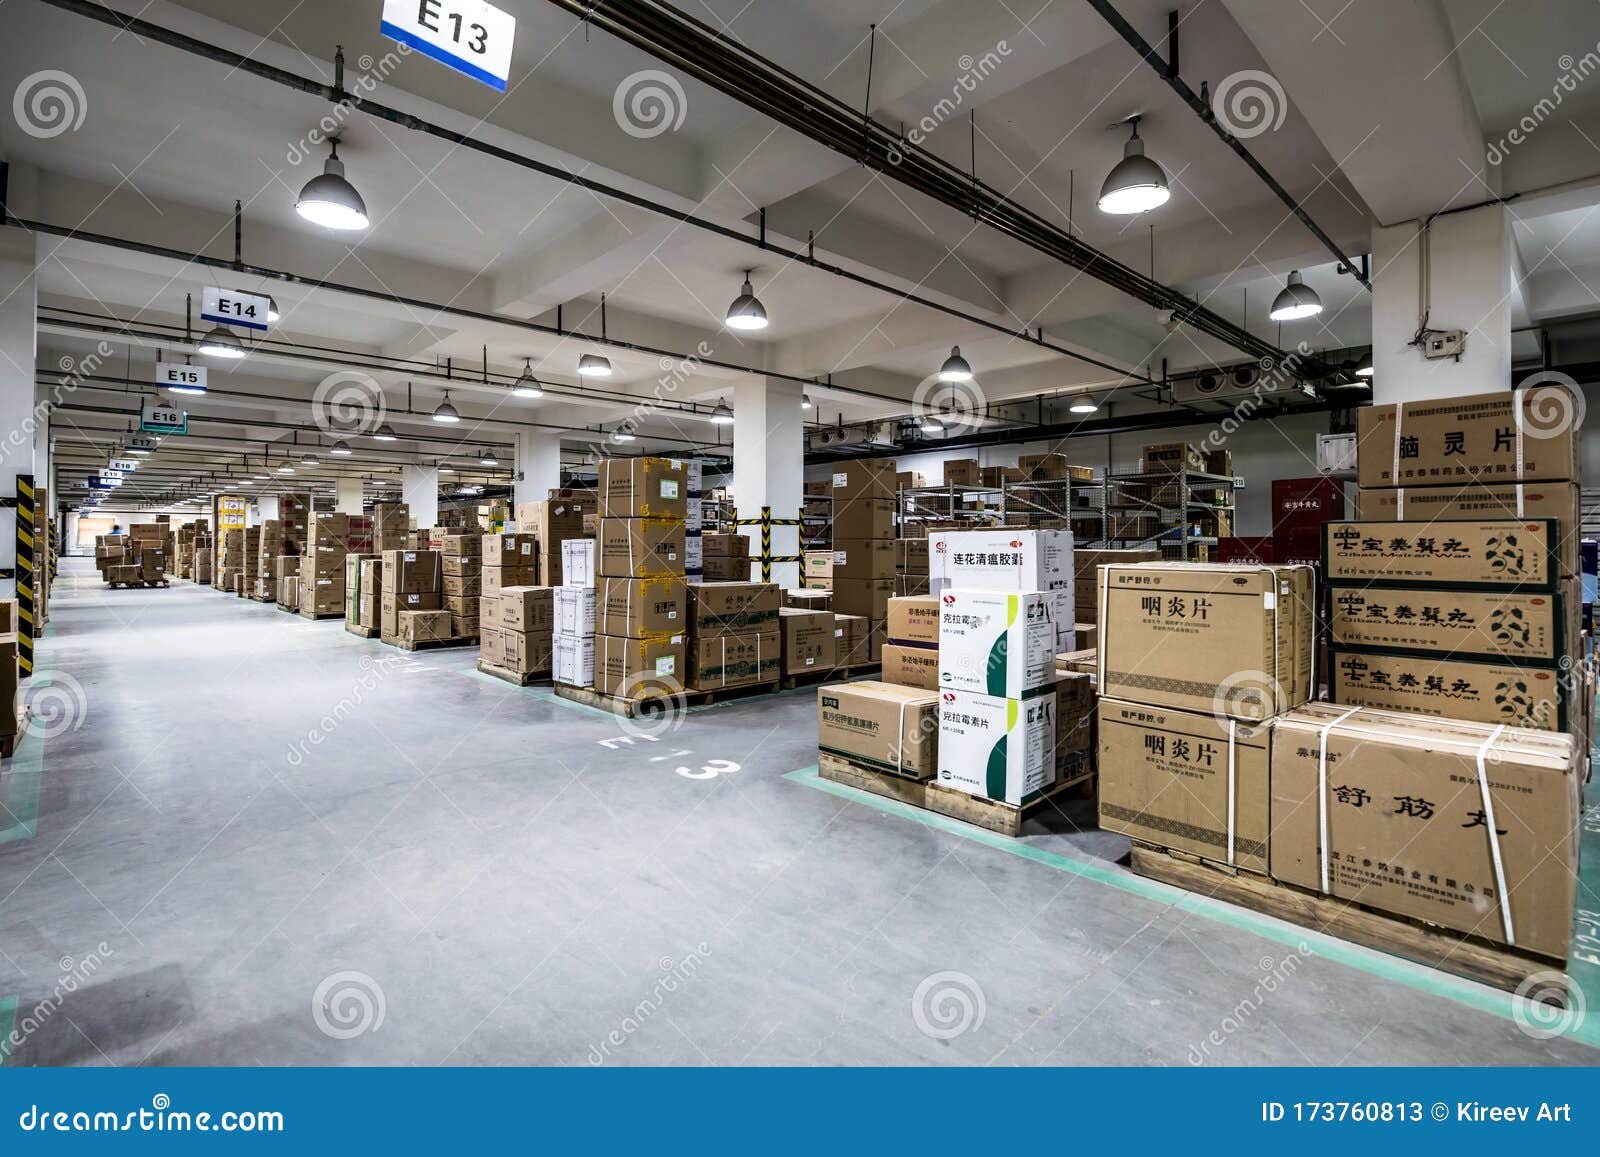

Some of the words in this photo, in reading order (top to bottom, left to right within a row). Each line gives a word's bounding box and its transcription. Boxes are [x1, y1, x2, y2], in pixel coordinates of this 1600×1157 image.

[418, 0, 489, 54] E13
[219, 299, 257, 318] E14
[168, 370, 198, 383] E15
[152, 412, 177, 422] E16
[132, 438, 151, 447] E17
[1400, 427, 1516, 459] 脑灵片
[953, 552, 1024, 566] 连花清瘟胶囊
[1141, 596, 1213, 620] 咽炎片
[943, 711, 990, 730] 克拉霉素片
[1144, 734, 1218, 766] 咽炎片
[1332, 785, 1509, 836] 舒筋丸
